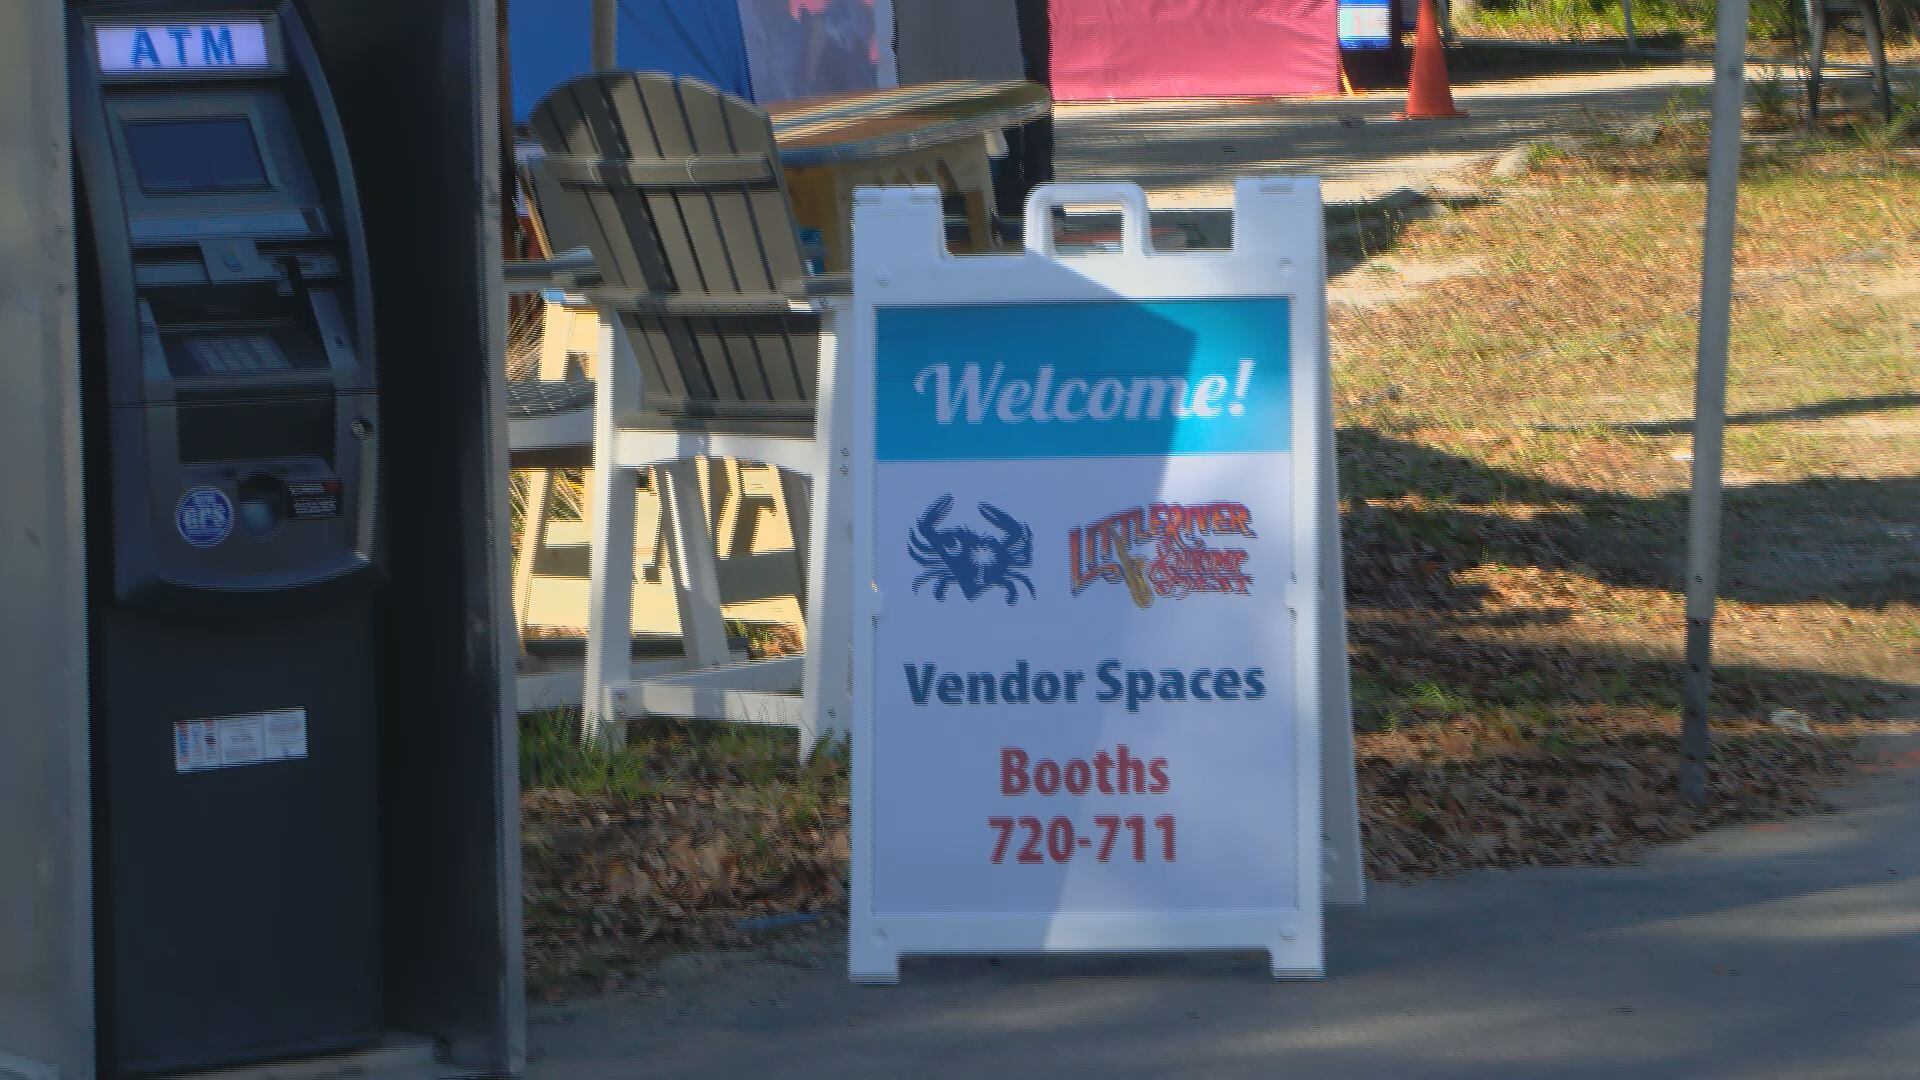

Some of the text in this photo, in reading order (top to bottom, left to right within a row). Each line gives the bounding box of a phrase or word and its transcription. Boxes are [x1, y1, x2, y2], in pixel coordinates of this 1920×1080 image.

[130, 25, 236, 68] ATM
[913, 358, 1256, 424] Welcome!
[182, 504, 228, 529] GPS
[903, 658, 1267, 714] Vendor Spaces
[1000, 743, 1170, 796] Booths
[988, 814, 1176, 864] 720-711
